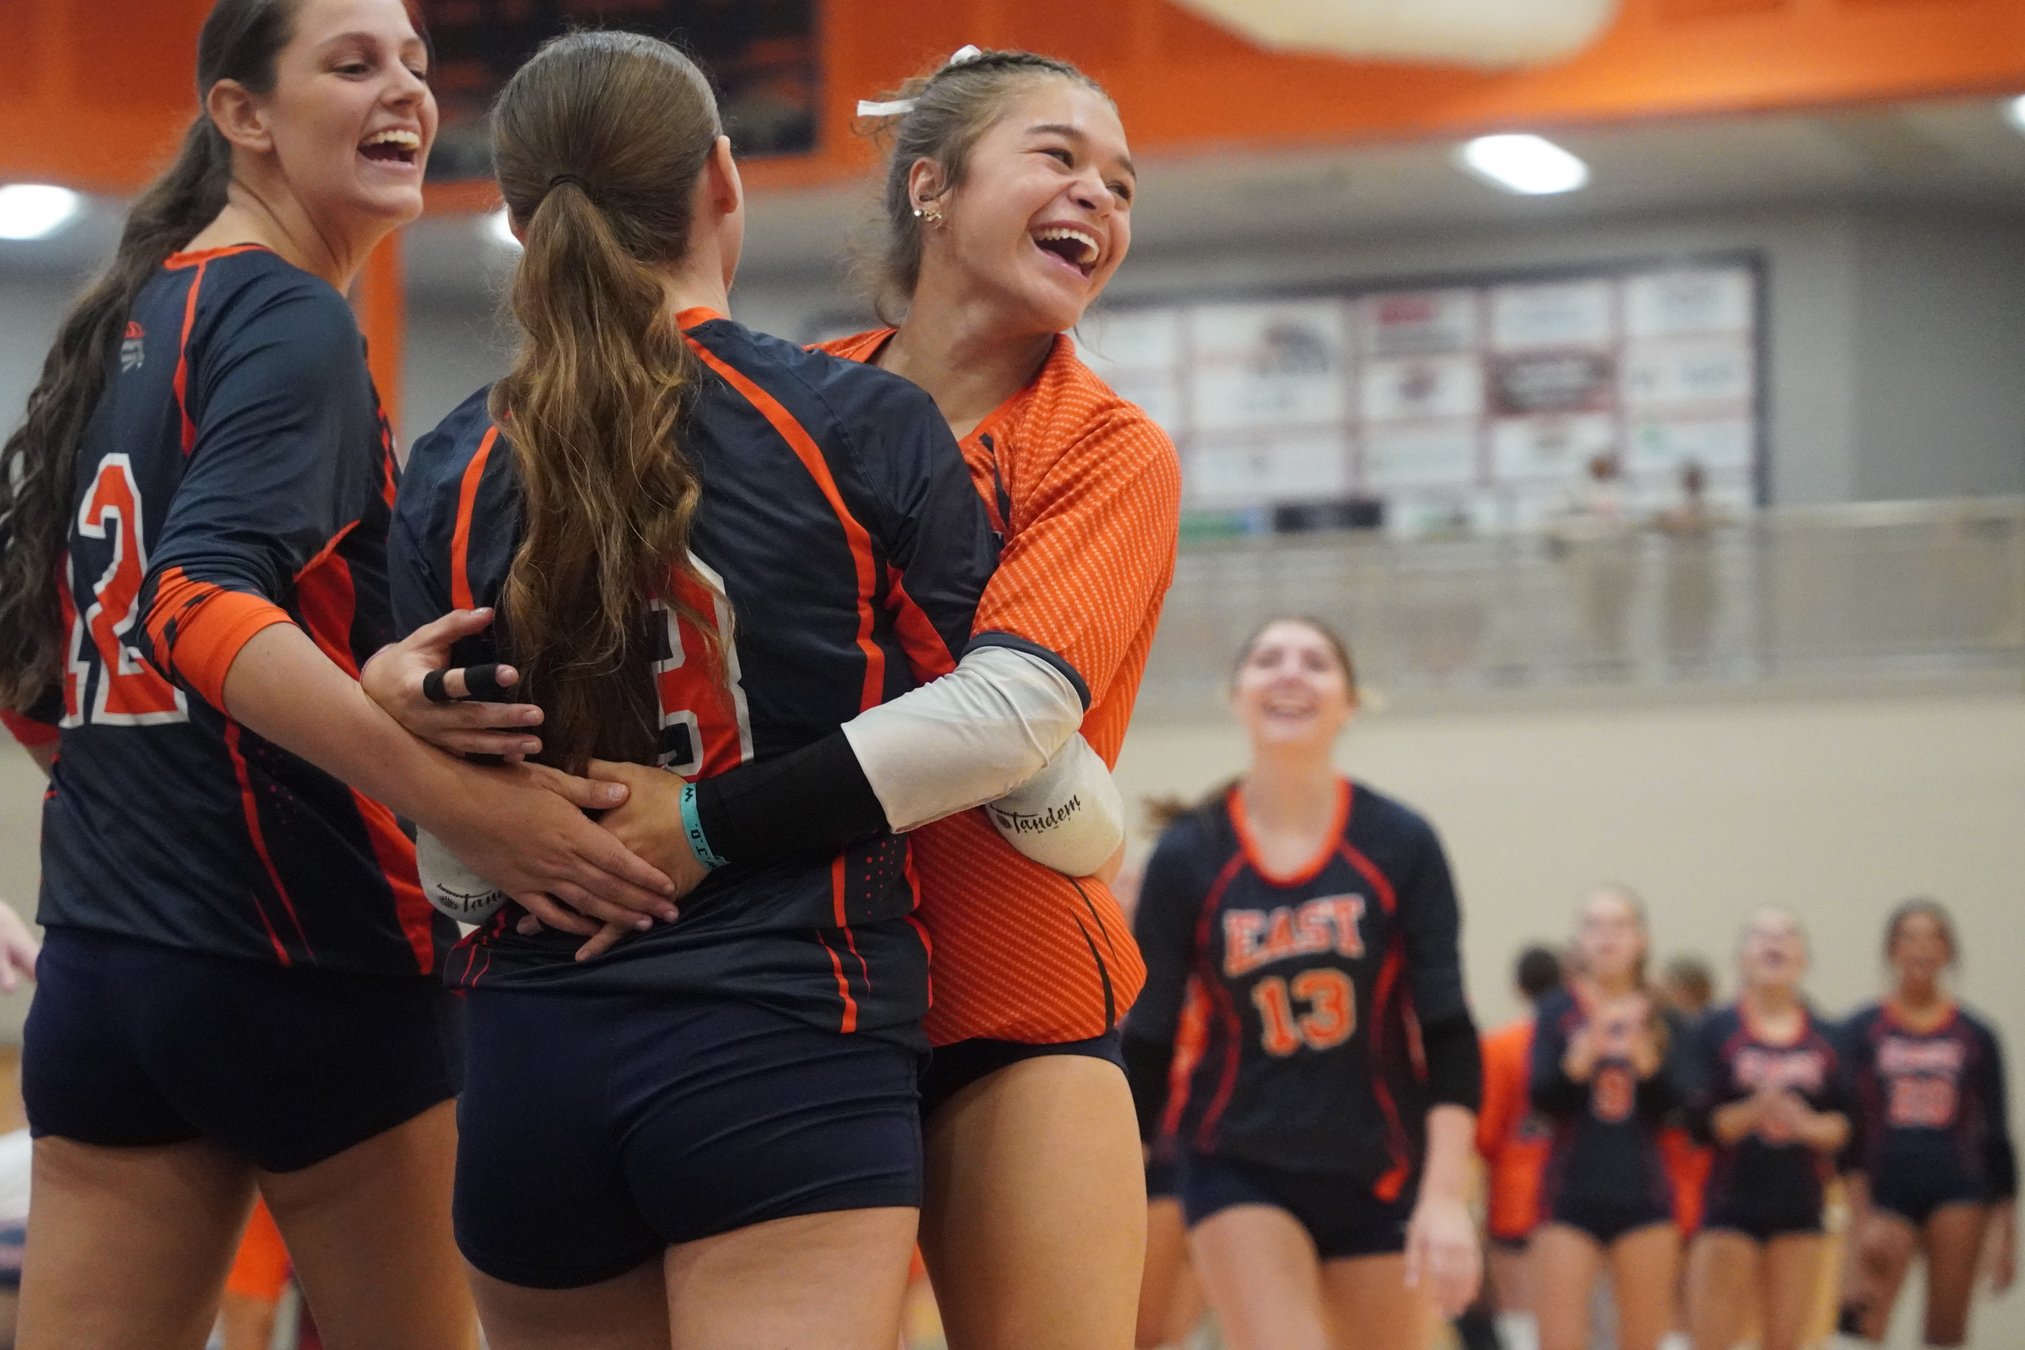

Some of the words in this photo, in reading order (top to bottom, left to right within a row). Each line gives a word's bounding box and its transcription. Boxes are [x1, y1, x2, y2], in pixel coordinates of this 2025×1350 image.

[989, 794, 1081, 834] Tandem
[1223, 893, 1366, 978] EAST
[1252, 968, 1356, 1056] 13
